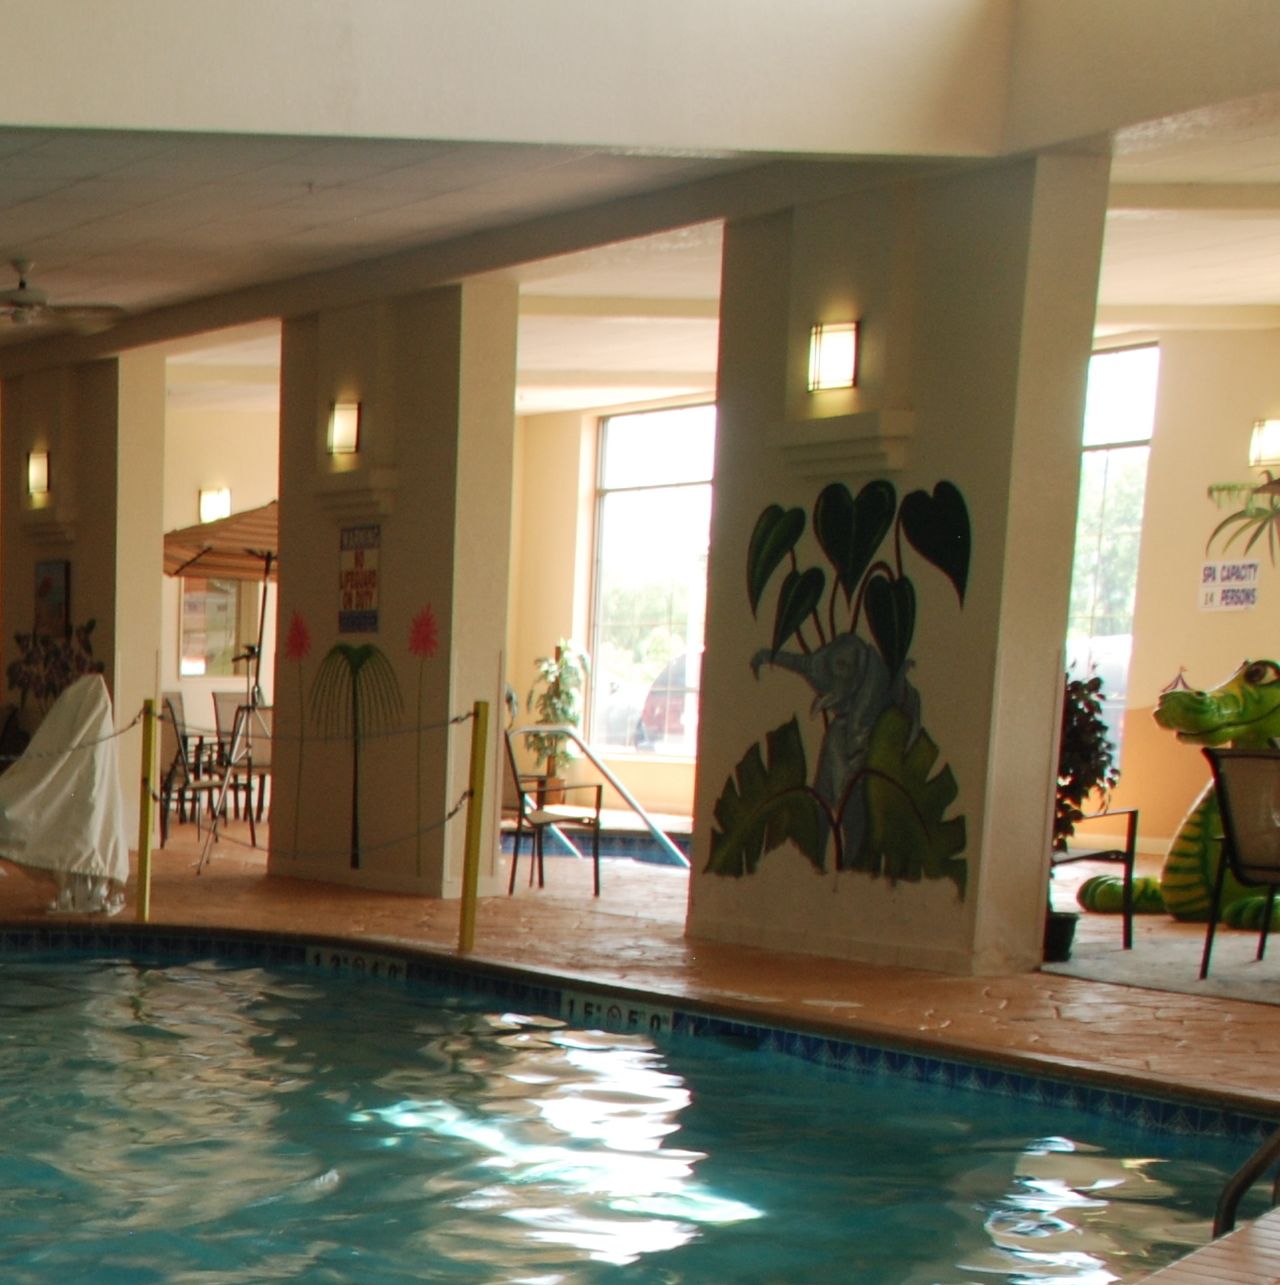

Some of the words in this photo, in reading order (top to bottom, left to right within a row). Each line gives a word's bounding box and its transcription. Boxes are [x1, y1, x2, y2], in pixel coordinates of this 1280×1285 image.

[1202, 565, 1216, 583] SPA
[1220, 563, 1258, 582] CAPACITY
[1220, 587, 1257, 606] PERSONS
